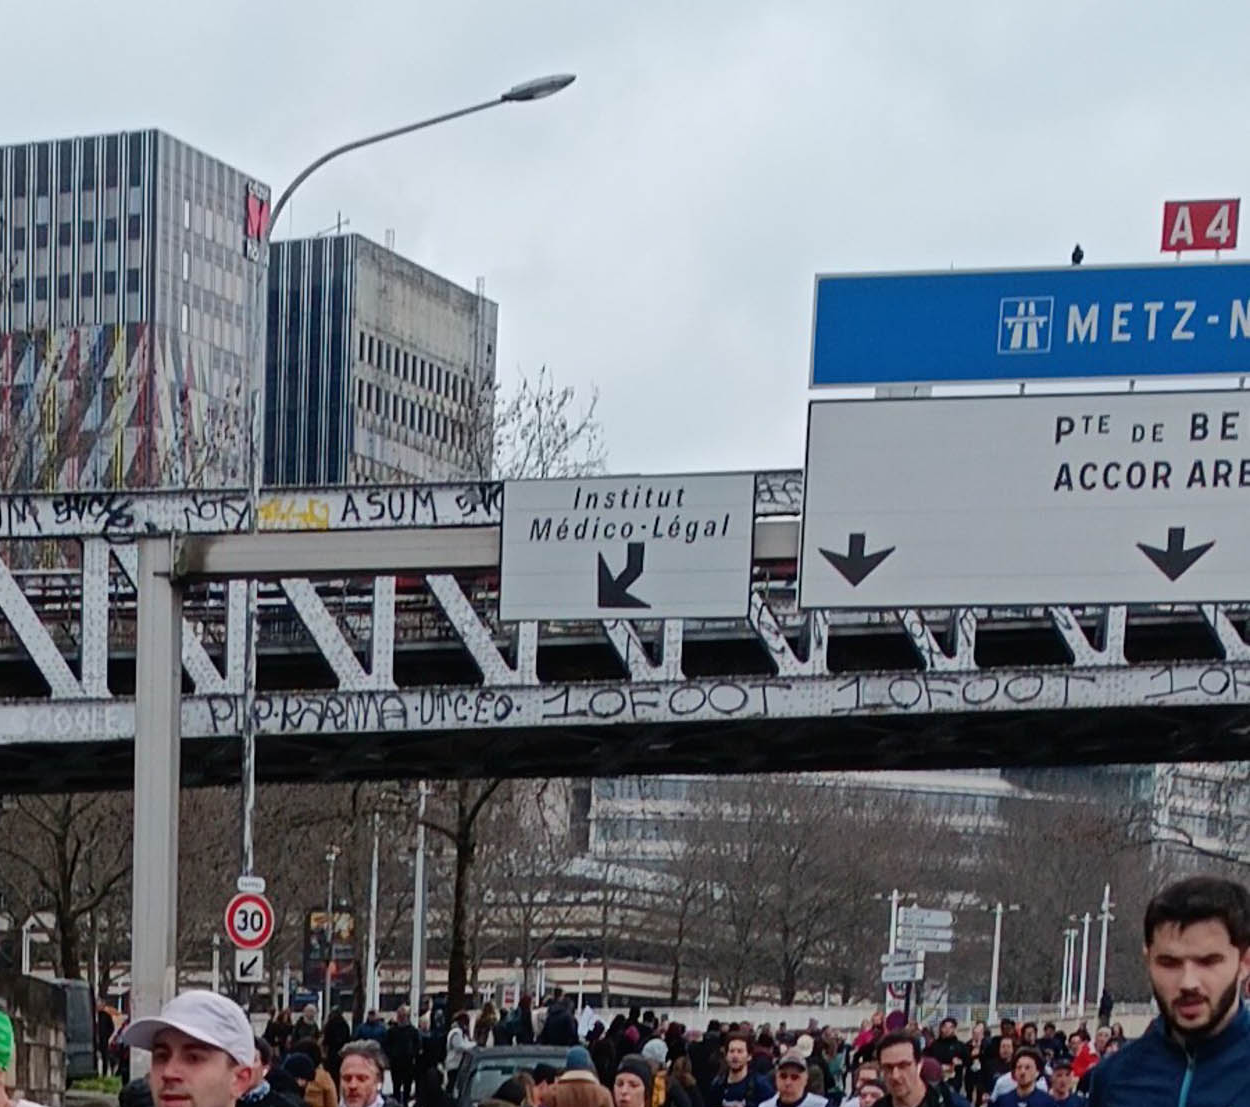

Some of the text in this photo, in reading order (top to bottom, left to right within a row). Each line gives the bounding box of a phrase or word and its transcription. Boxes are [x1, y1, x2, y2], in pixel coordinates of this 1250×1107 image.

[1131, 424, 1164, 443] DE
[1053, 460, 1172, 491] ACCOR
[341, 489, 438, 523] ASUM
[573, 485, 685, 511] Institut
[237, 909, 263, 932] 30
